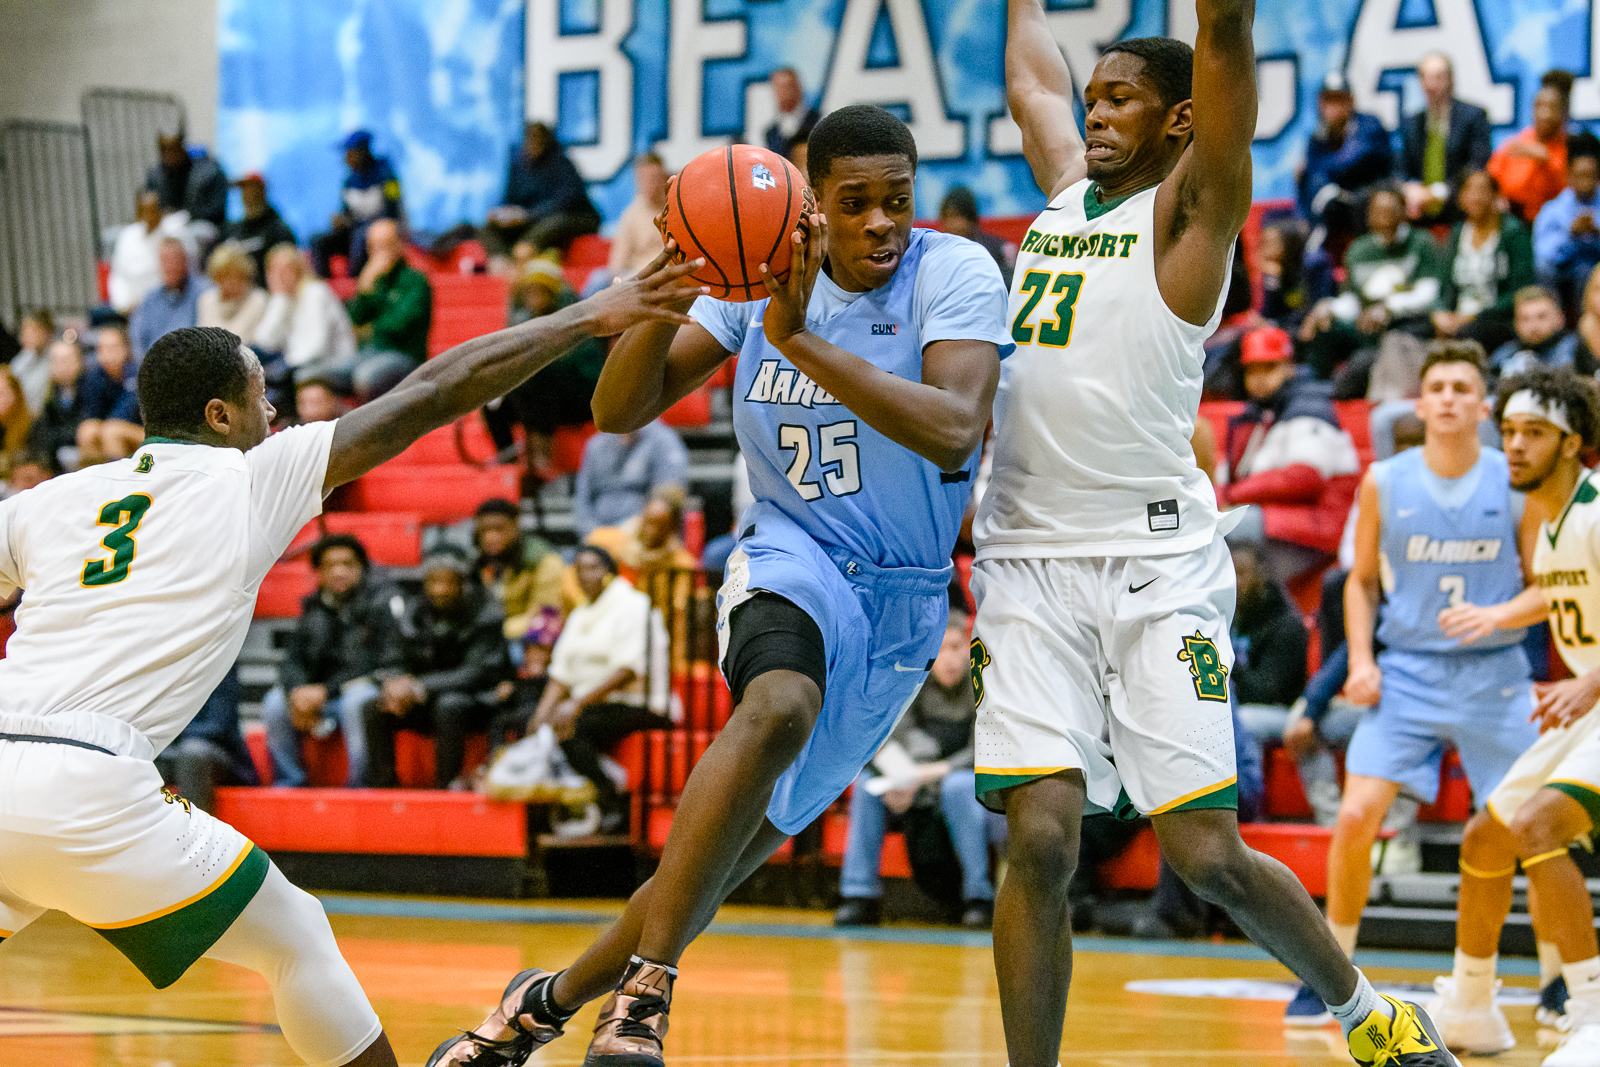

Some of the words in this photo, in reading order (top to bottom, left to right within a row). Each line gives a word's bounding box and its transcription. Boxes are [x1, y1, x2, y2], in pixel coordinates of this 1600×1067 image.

[871, 323, 898, 335] CUNY
[1011, 268, 1086, 349] 23
[778, 419, 862, 502] 25
[79, 491, 154, 588] 3
[1158, 503, 1167, 513] L
